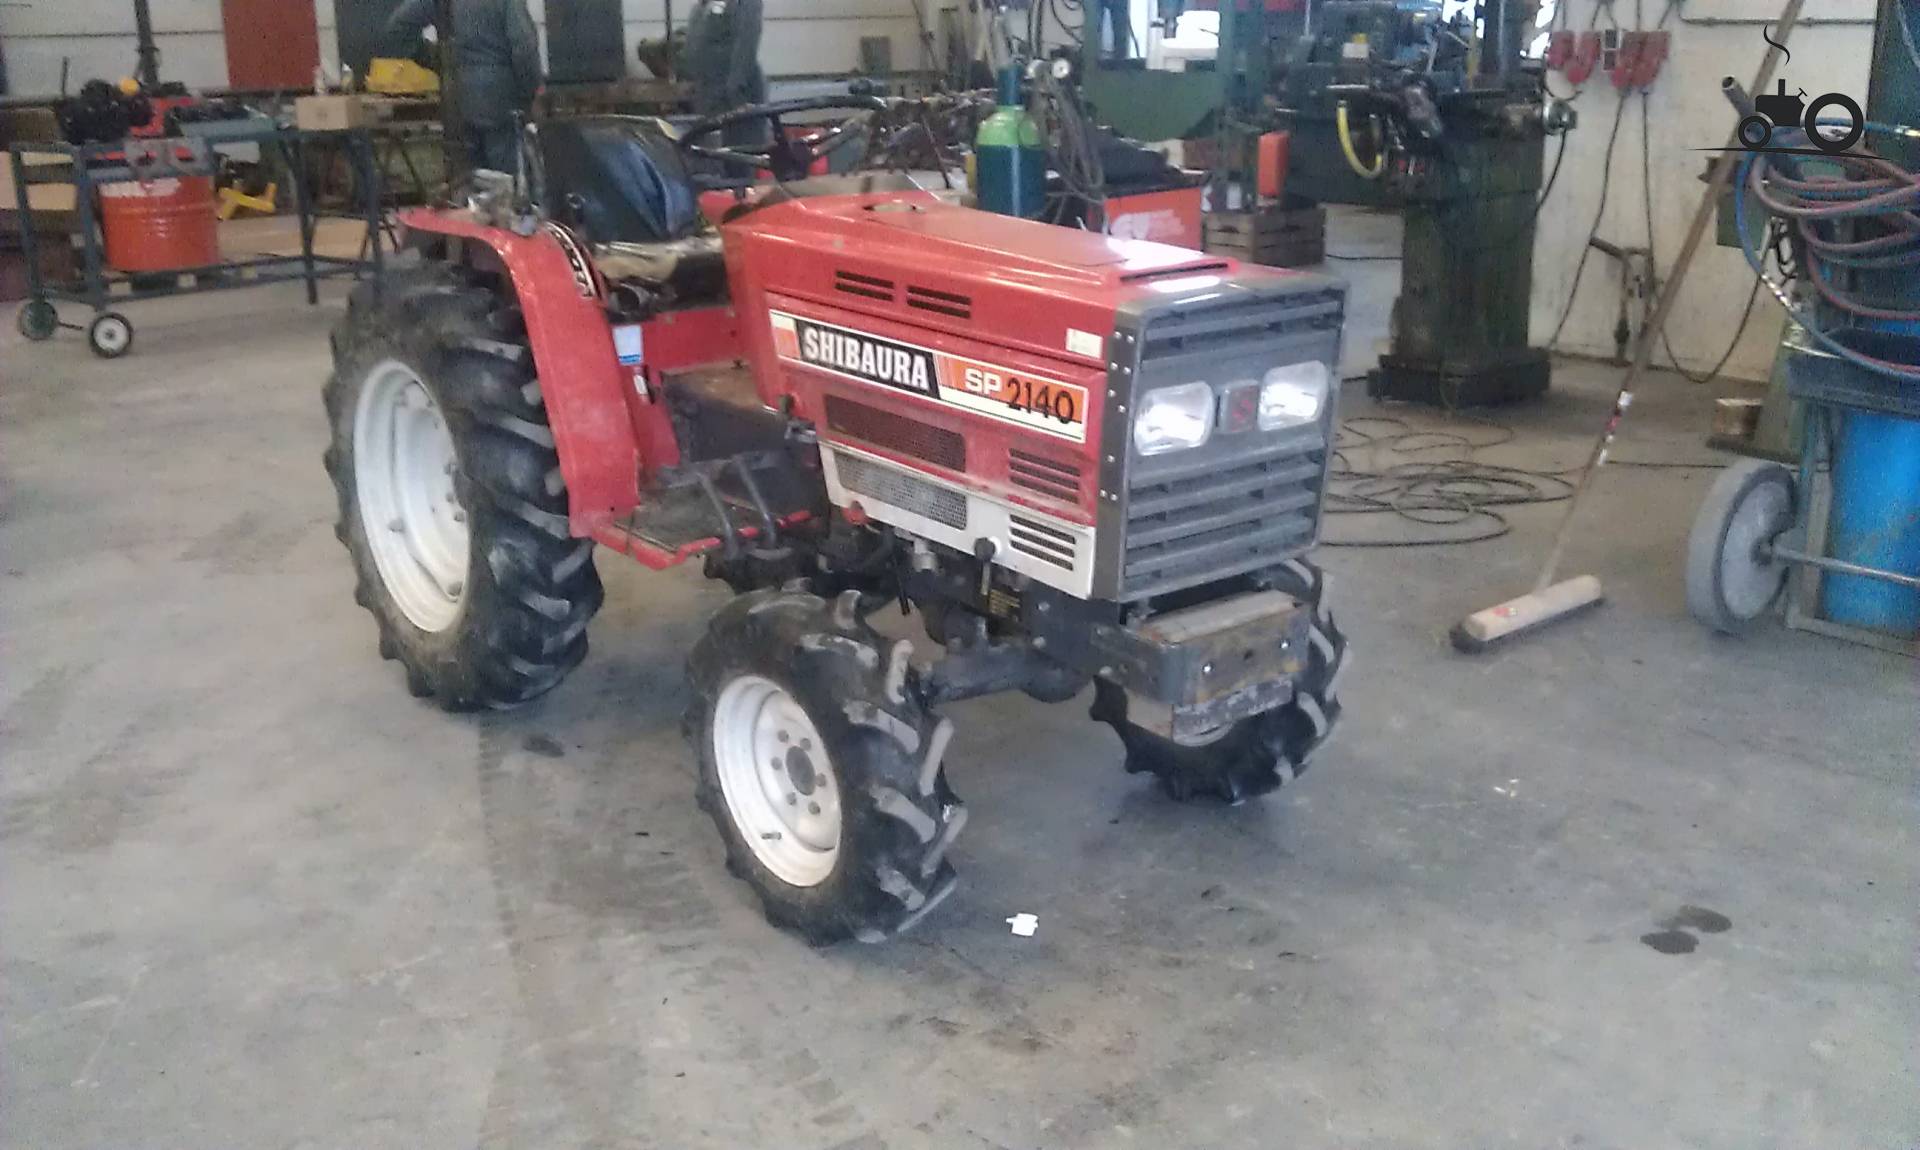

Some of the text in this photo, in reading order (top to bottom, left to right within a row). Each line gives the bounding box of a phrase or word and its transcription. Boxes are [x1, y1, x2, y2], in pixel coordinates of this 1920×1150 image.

[803, 326, 1074, 425] SHIBAURA SP 2140
